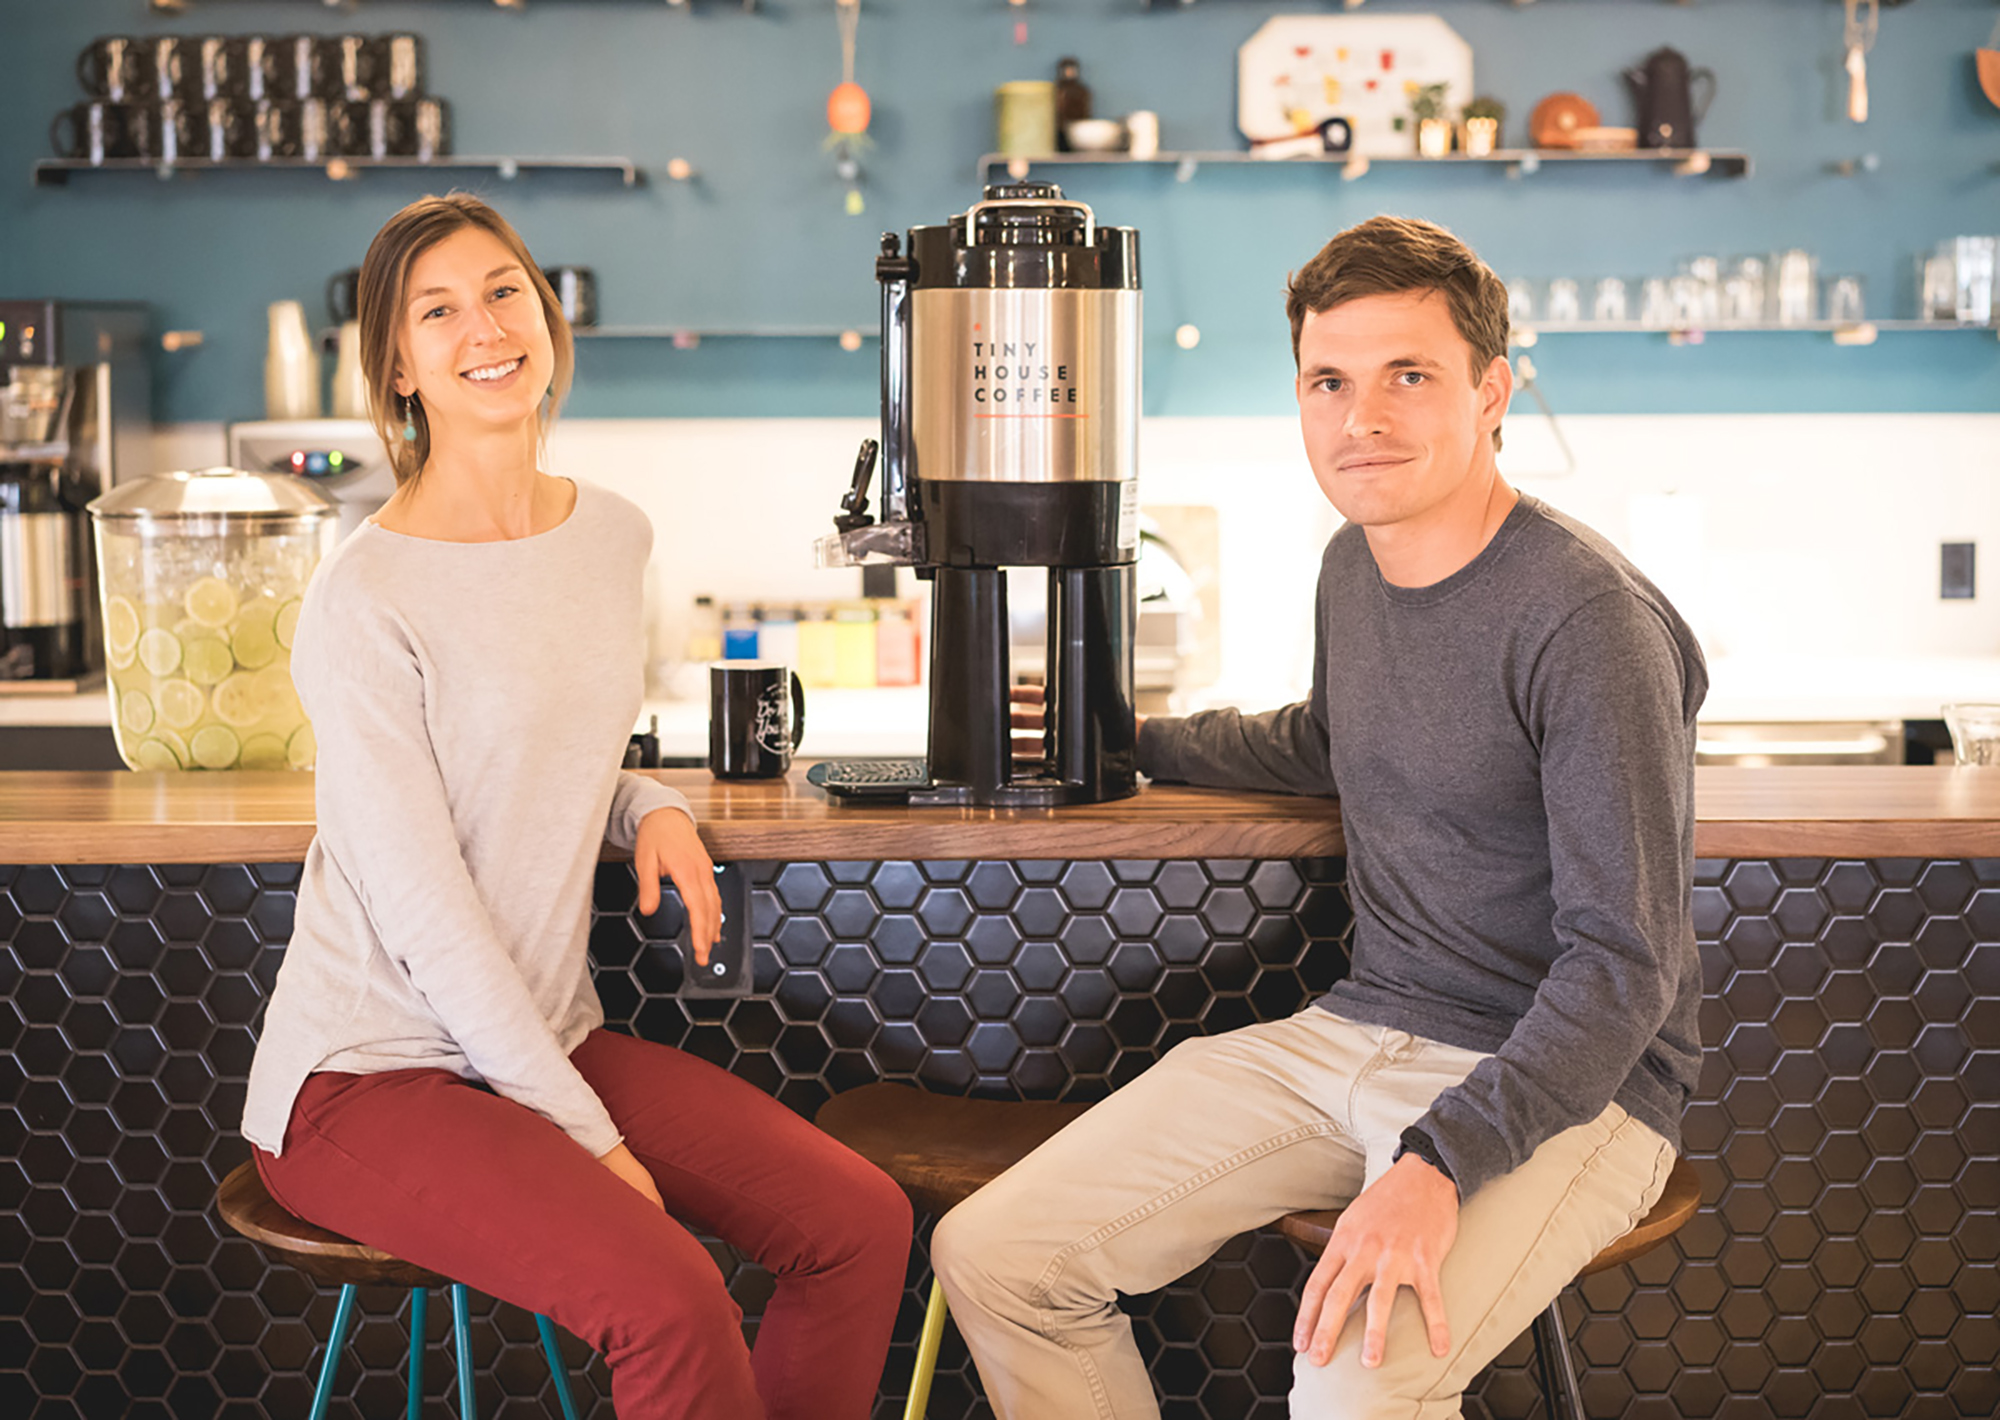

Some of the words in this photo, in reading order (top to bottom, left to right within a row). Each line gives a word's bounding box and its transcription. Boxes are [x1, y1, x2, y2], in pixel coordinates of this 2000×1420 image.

[973, 343, 1037, 357] TINY
[974, 365, 1067, 380] HOUSE
[974, 388, 1077, 403] COFFEE
